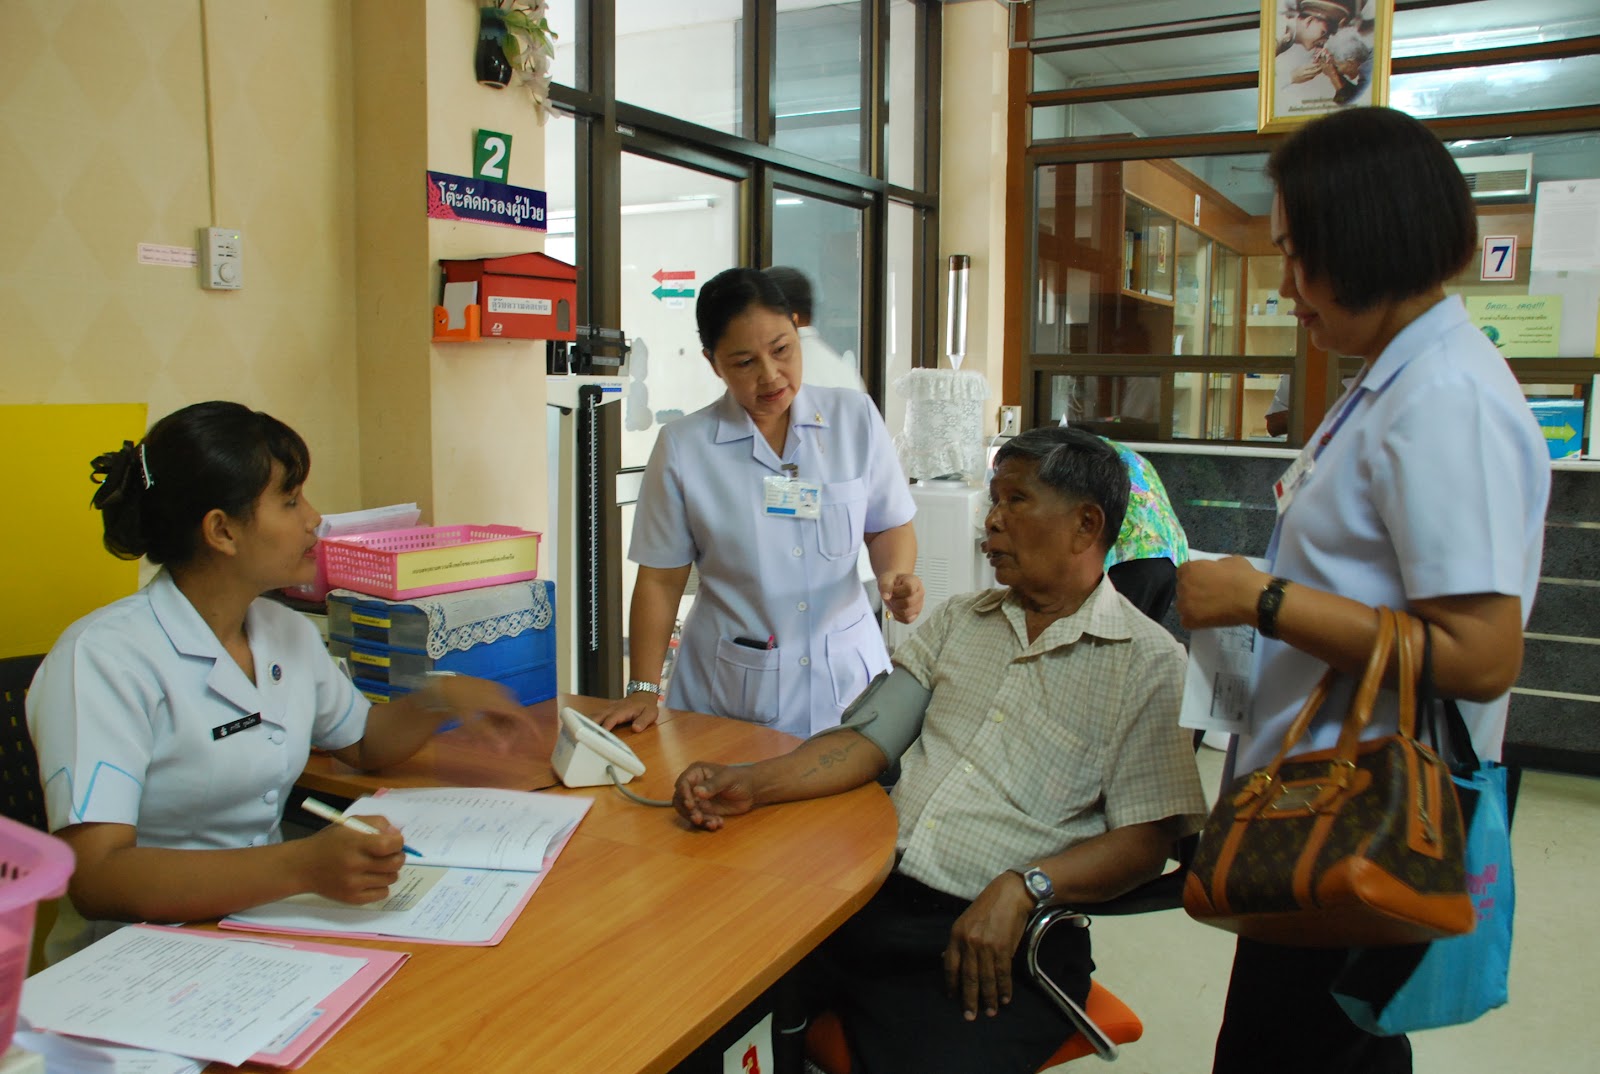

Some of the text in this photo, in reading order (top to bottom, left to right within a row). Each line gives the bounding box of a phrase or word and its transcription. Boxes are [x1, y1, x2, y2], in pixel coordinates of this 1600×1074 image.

[480, 136, 506, 179] 2
[438, 181, 544, 224] โต๊ะคัดกรองผู้ป่วย
[1491, 245, 1511, 273] 7
